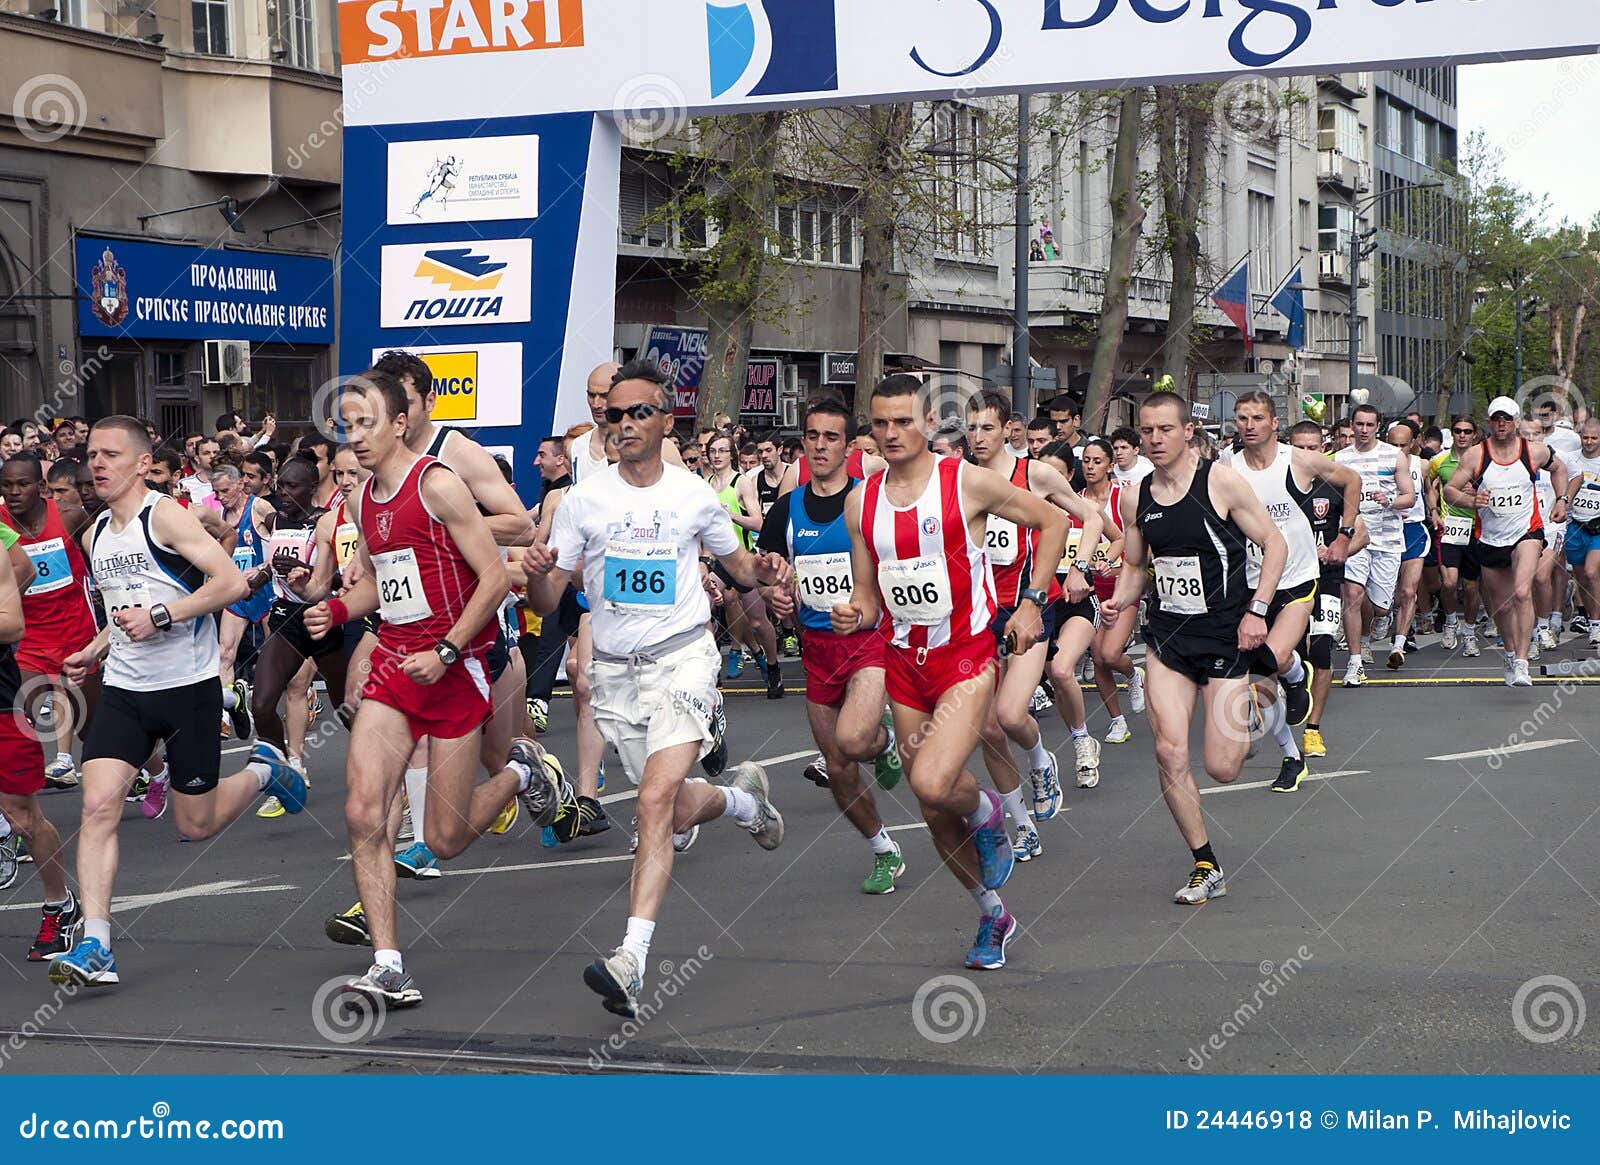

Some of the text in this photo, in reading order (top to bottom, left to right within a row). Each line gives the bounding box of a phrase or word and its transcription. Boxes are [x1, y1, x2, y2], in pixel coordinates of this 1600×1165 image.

[366, 0, 562, 57] START
[191, 264, 277, 294] ПРОДАВНИЦА
[136, 297, 327, 331] СРПСКЕ ПРАВОСЛАВНЕ ЦРКВЕ
[403, 296, 504, 320] ПОШТА
[1490, 494, 1522, 507] 1212
[1573, 497, 1600, 510] 2263
[633, 528, 656, 538] 2012
[1445, 526, 1470, 537] 2074
[37, 561, 50, 577] 8
[94, 552, 147, 573] ULTIMATE
[381, 576, 413, 603] 821
[615, 568, 666, 594] 186
[801, 574, 853, 596] 1984
[1157, 576, 1202, 597] 1738
[891, 582, 939, 606] 806
